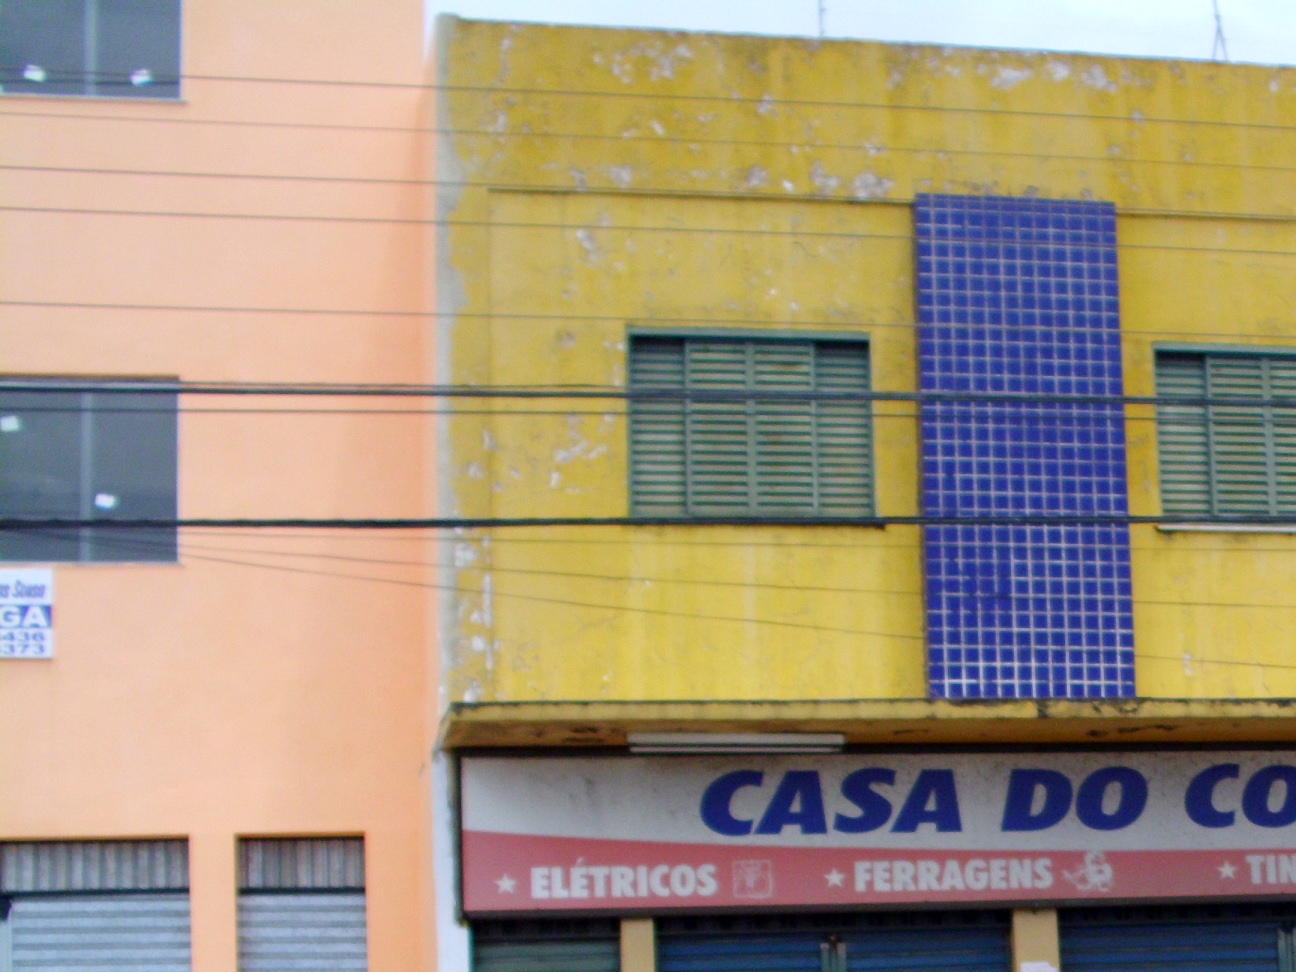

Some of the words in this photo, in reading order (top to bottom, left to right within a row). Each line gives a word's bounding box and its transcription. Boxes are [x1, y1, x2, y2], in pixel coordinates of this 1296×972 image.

[0, 606, 49, 629] GA
[698, 766, 964, 837] CASA
[1000, 767, 1150, 832] DO
[530, 858, 718, 900] ELÉTRICOS
[853, 859, 1055, 893] FERRAGENS
